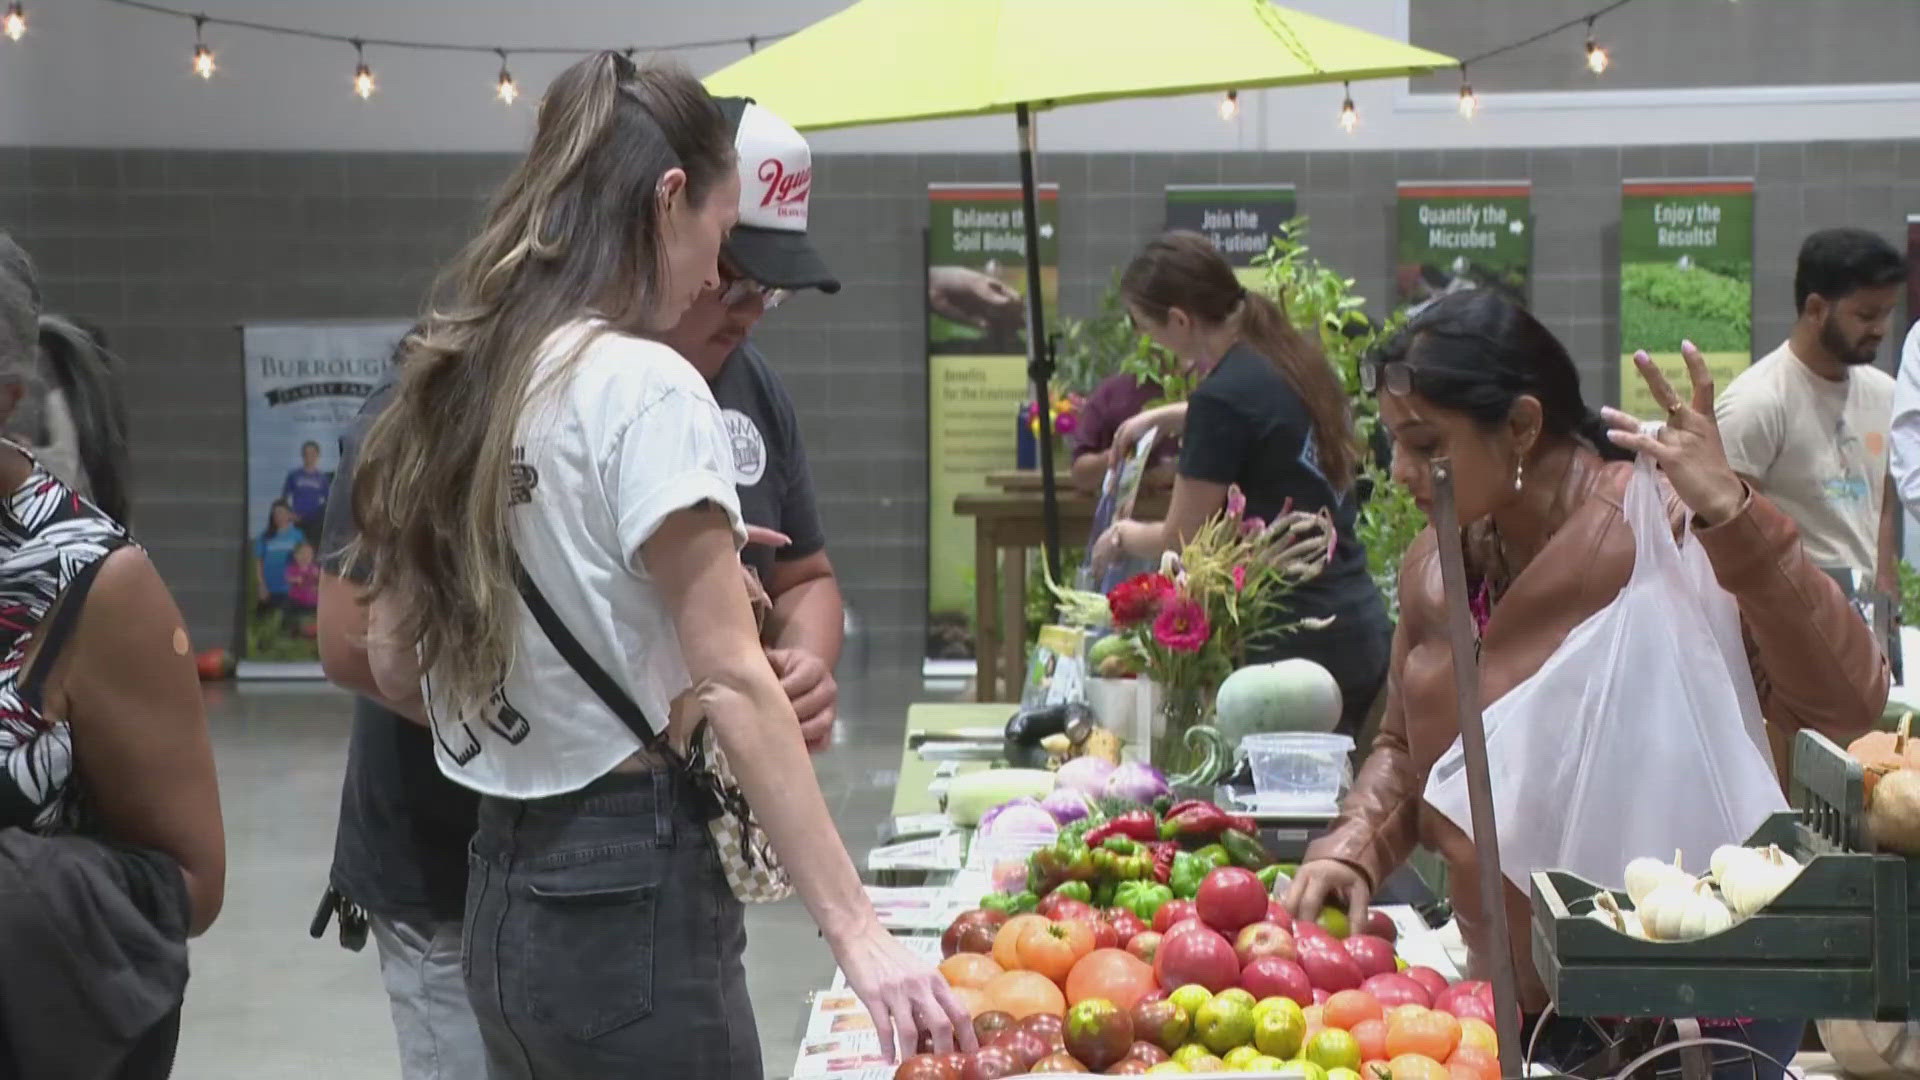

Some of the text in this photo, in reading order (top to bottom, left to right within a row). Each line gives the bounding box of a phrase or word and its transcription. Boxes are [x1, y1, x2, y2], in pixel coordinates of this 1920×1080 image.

[953, 207, 1025, 228] Balance th
[1202, 207, 1259, 230] Join the
[1419, 203, 1507, 232] Quantify the
[1654, 202, 1721, 228] Enjoy the
[953, 231, 1025, 257] Soil Biolog
[1429, 227, 1496, 248] Microbes
[1657, 225, 1717, 247] Results!
[943, 368, 986, 381] Benefits
[943, 386, 958, 400] for
[960, 386, 977, 400] the
